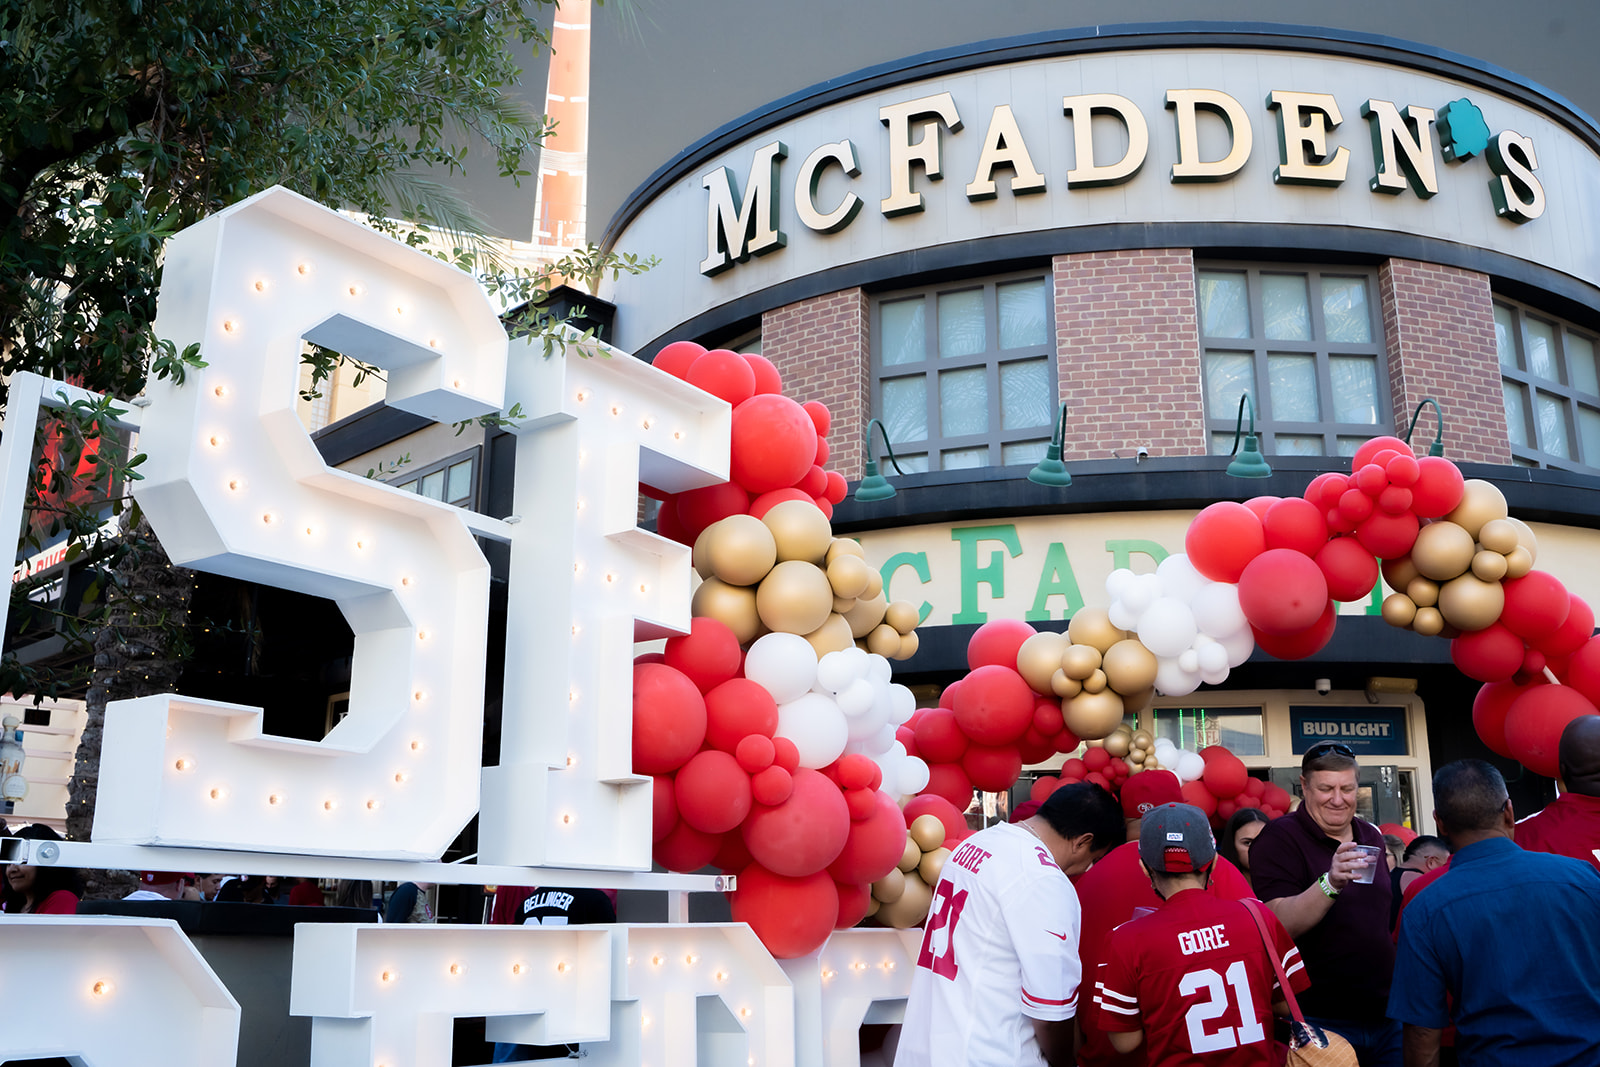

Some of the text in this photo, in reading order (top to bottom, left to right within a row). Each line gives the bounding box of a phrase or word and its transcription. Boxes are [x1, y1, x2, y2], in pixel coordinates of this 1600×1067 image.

[92, 185, 732, 871] SF
[1303, 722, 1390, 736] BUD LIGHT
[952, 842, 992, 875] GORE
[523, 891, 575, 914] BELLINGER
[917, 878, 969, 982] 21
[1178, 924, 1230, 956] GORE
[1178, 960, 1266, 1055] 21
